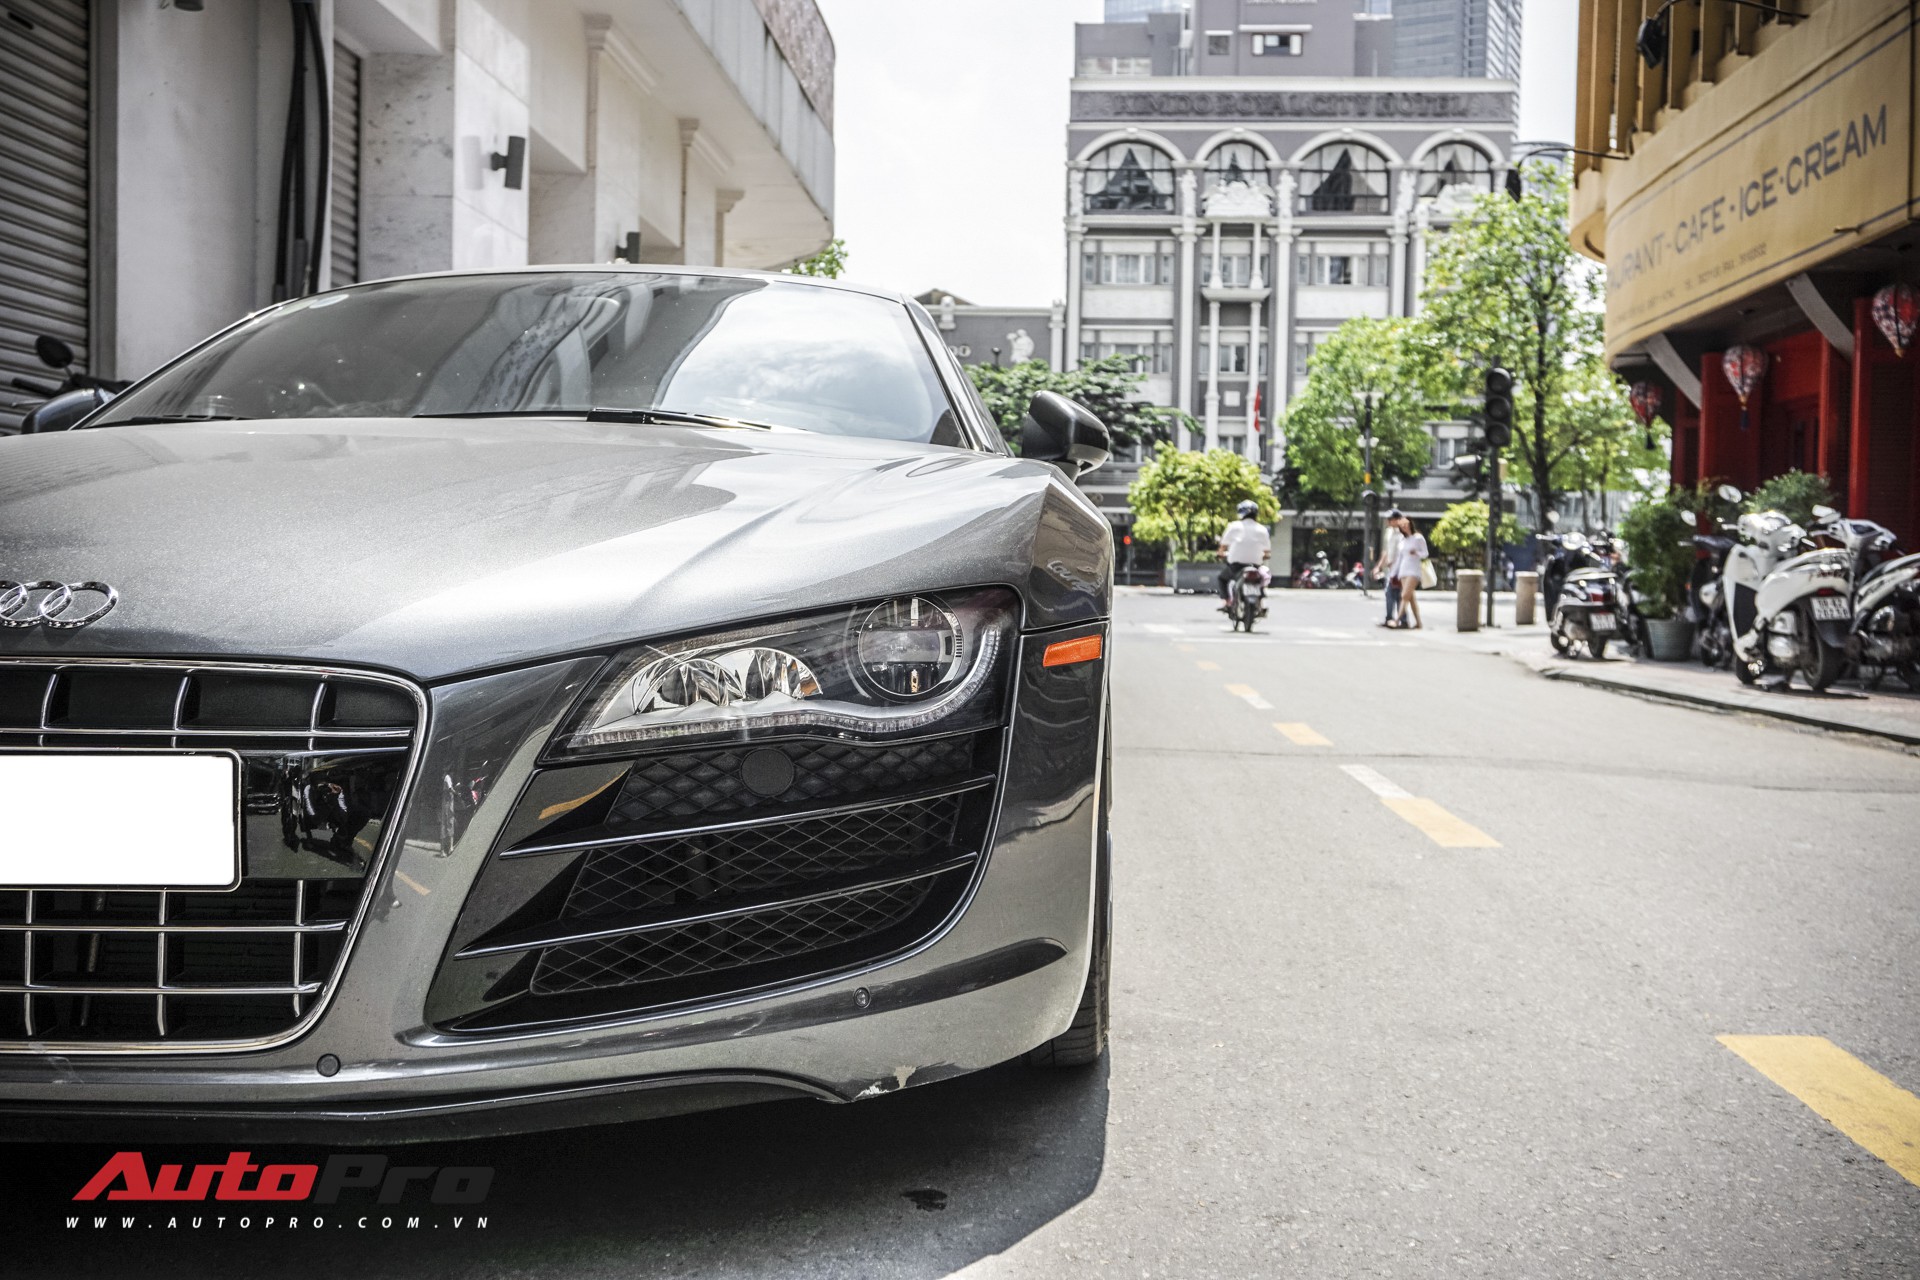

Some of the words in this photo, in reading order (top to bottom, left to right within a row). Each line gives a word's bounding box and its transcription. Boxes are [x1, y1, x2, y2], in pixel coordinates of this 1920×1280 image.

[1216, 93, 1301, 117] ROYAL
[1310, 93, 1371, 117] CITY
[1375, 93, 1469, 117] HOTEL
